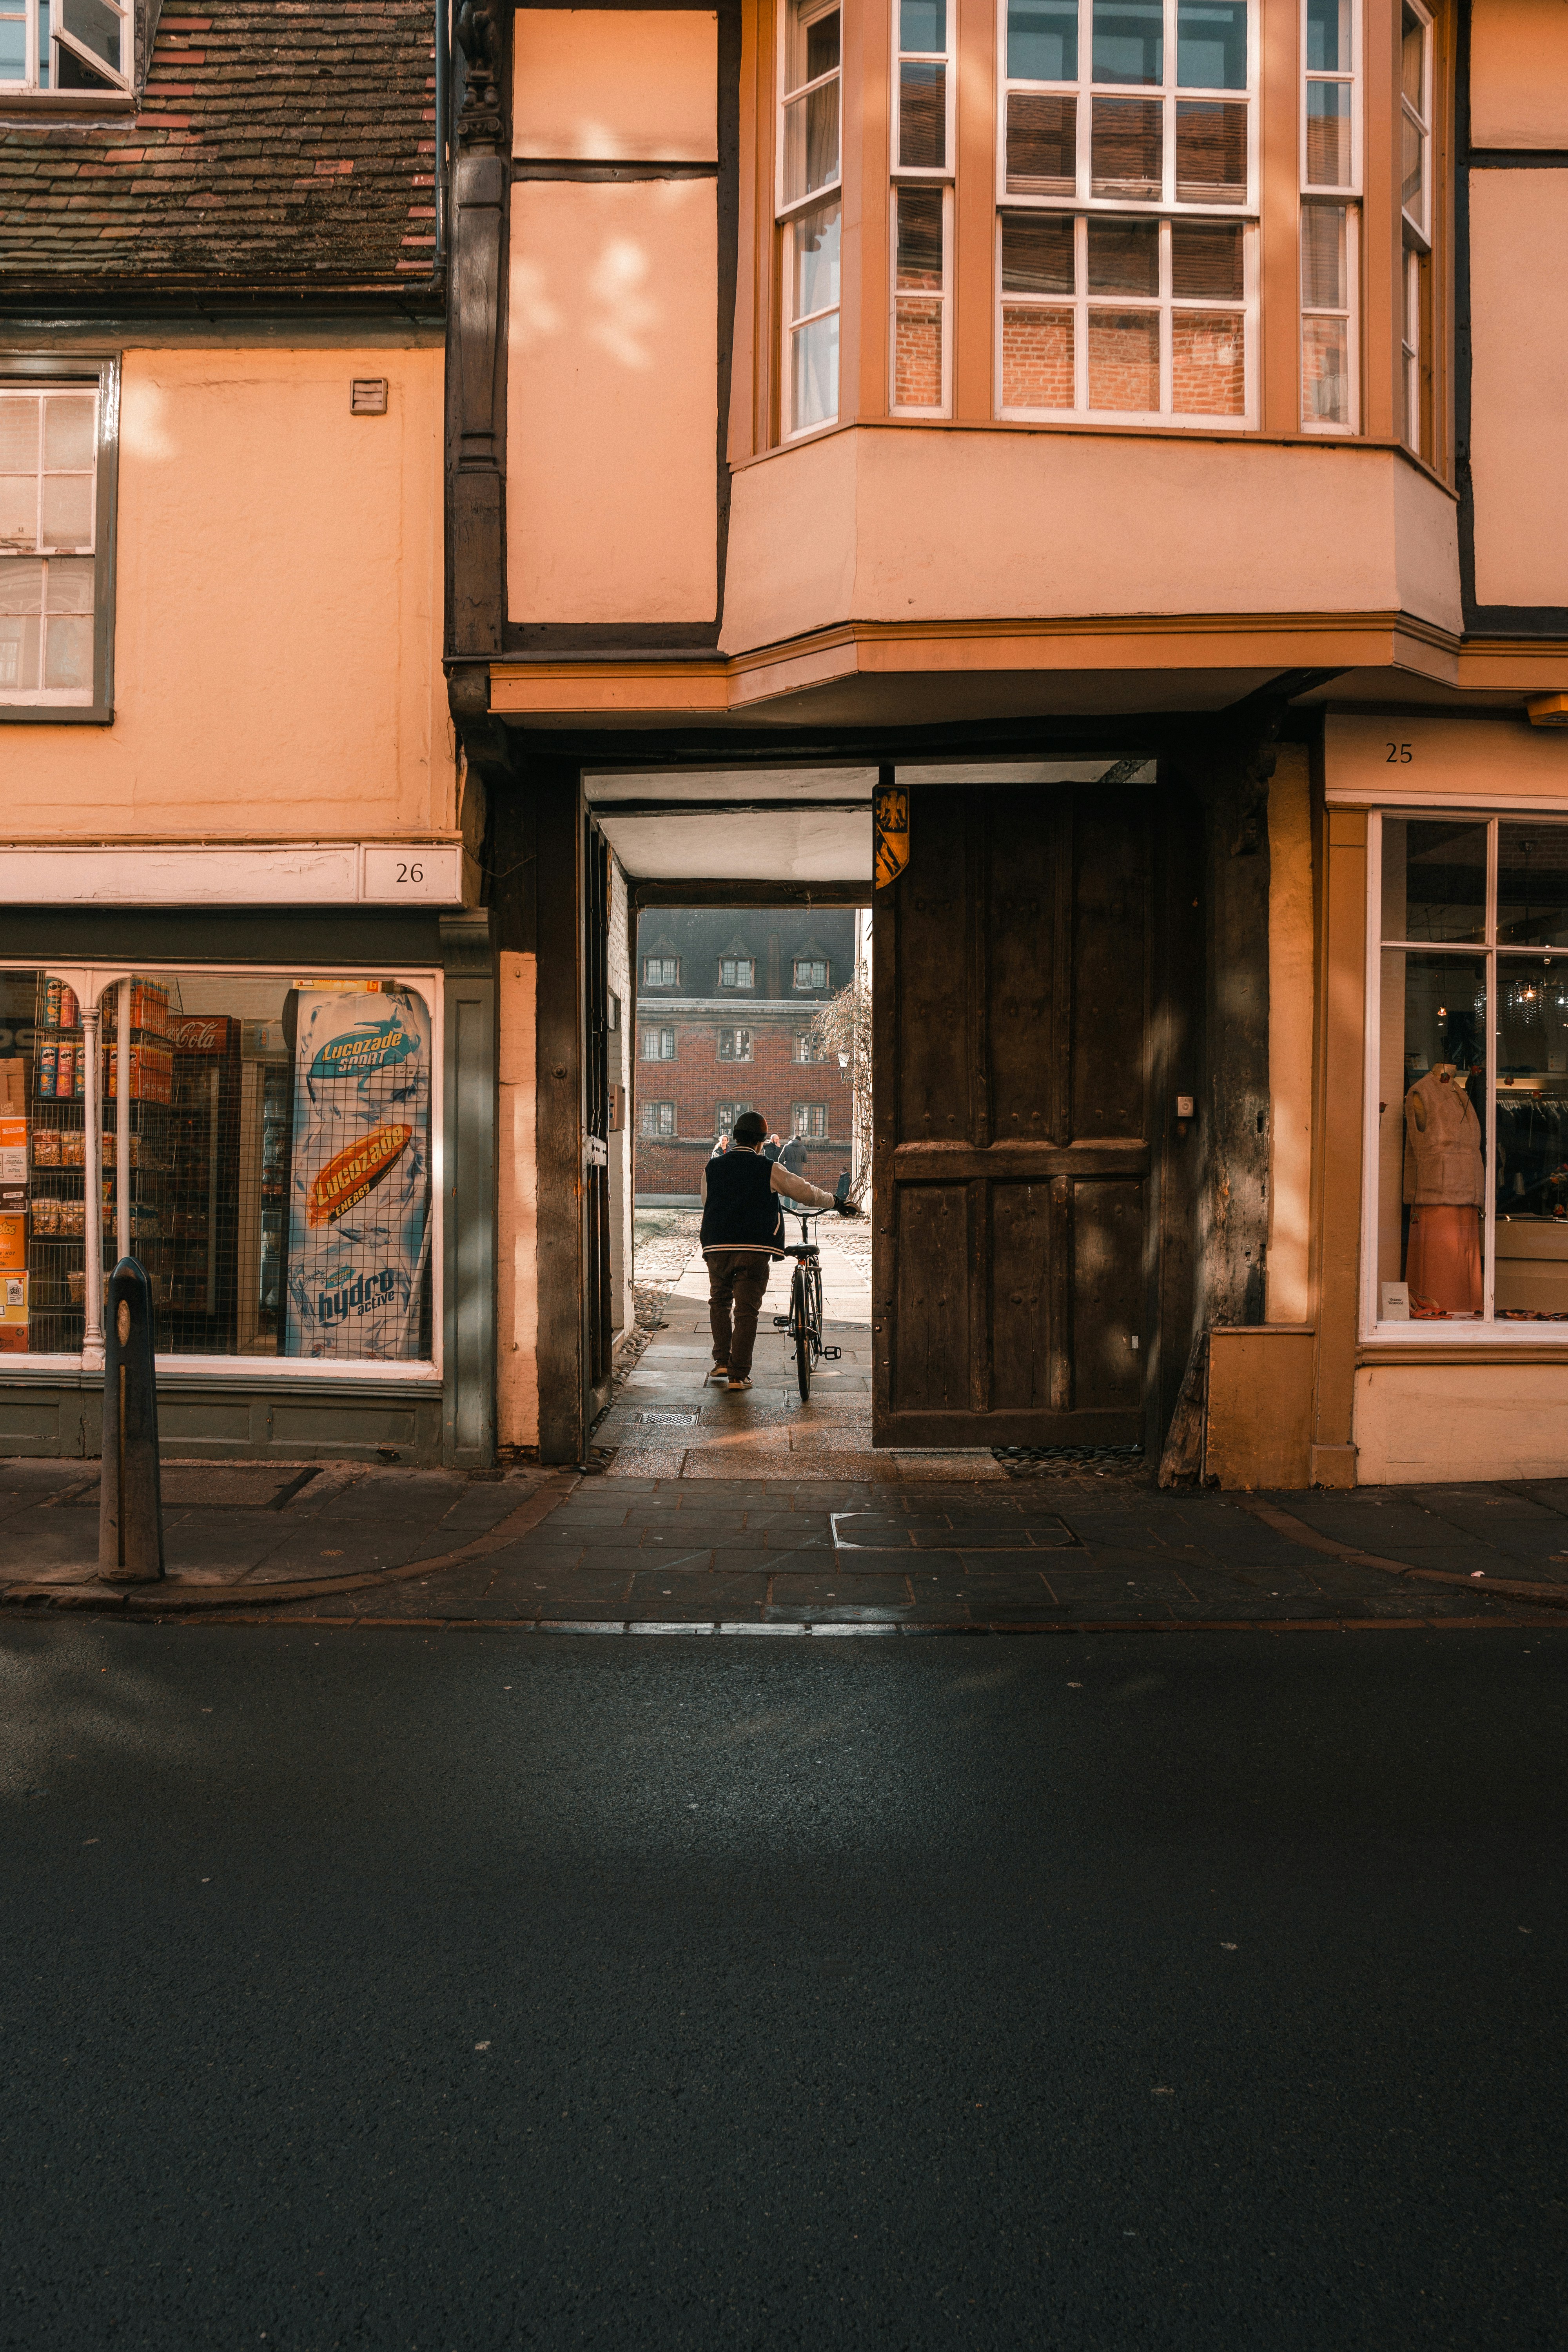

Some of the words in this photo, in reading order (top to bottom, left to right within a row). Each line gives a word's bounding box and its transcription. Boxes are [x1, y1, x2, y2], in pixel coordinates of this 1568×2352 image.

[1386, 743, 1412, 763] 25
[396, 863, 423, 882] 26
[322, 1031, 402, 1061] Lucozade
[338, 1049, 388, 1072] SPORT
[316, 1125, 403, 1207] Lucozade
[336, 1182, 370, 1217] ENERGY
[319, 1269, 394, 1328] hydro
[358, 1290, 395, 1316] active
